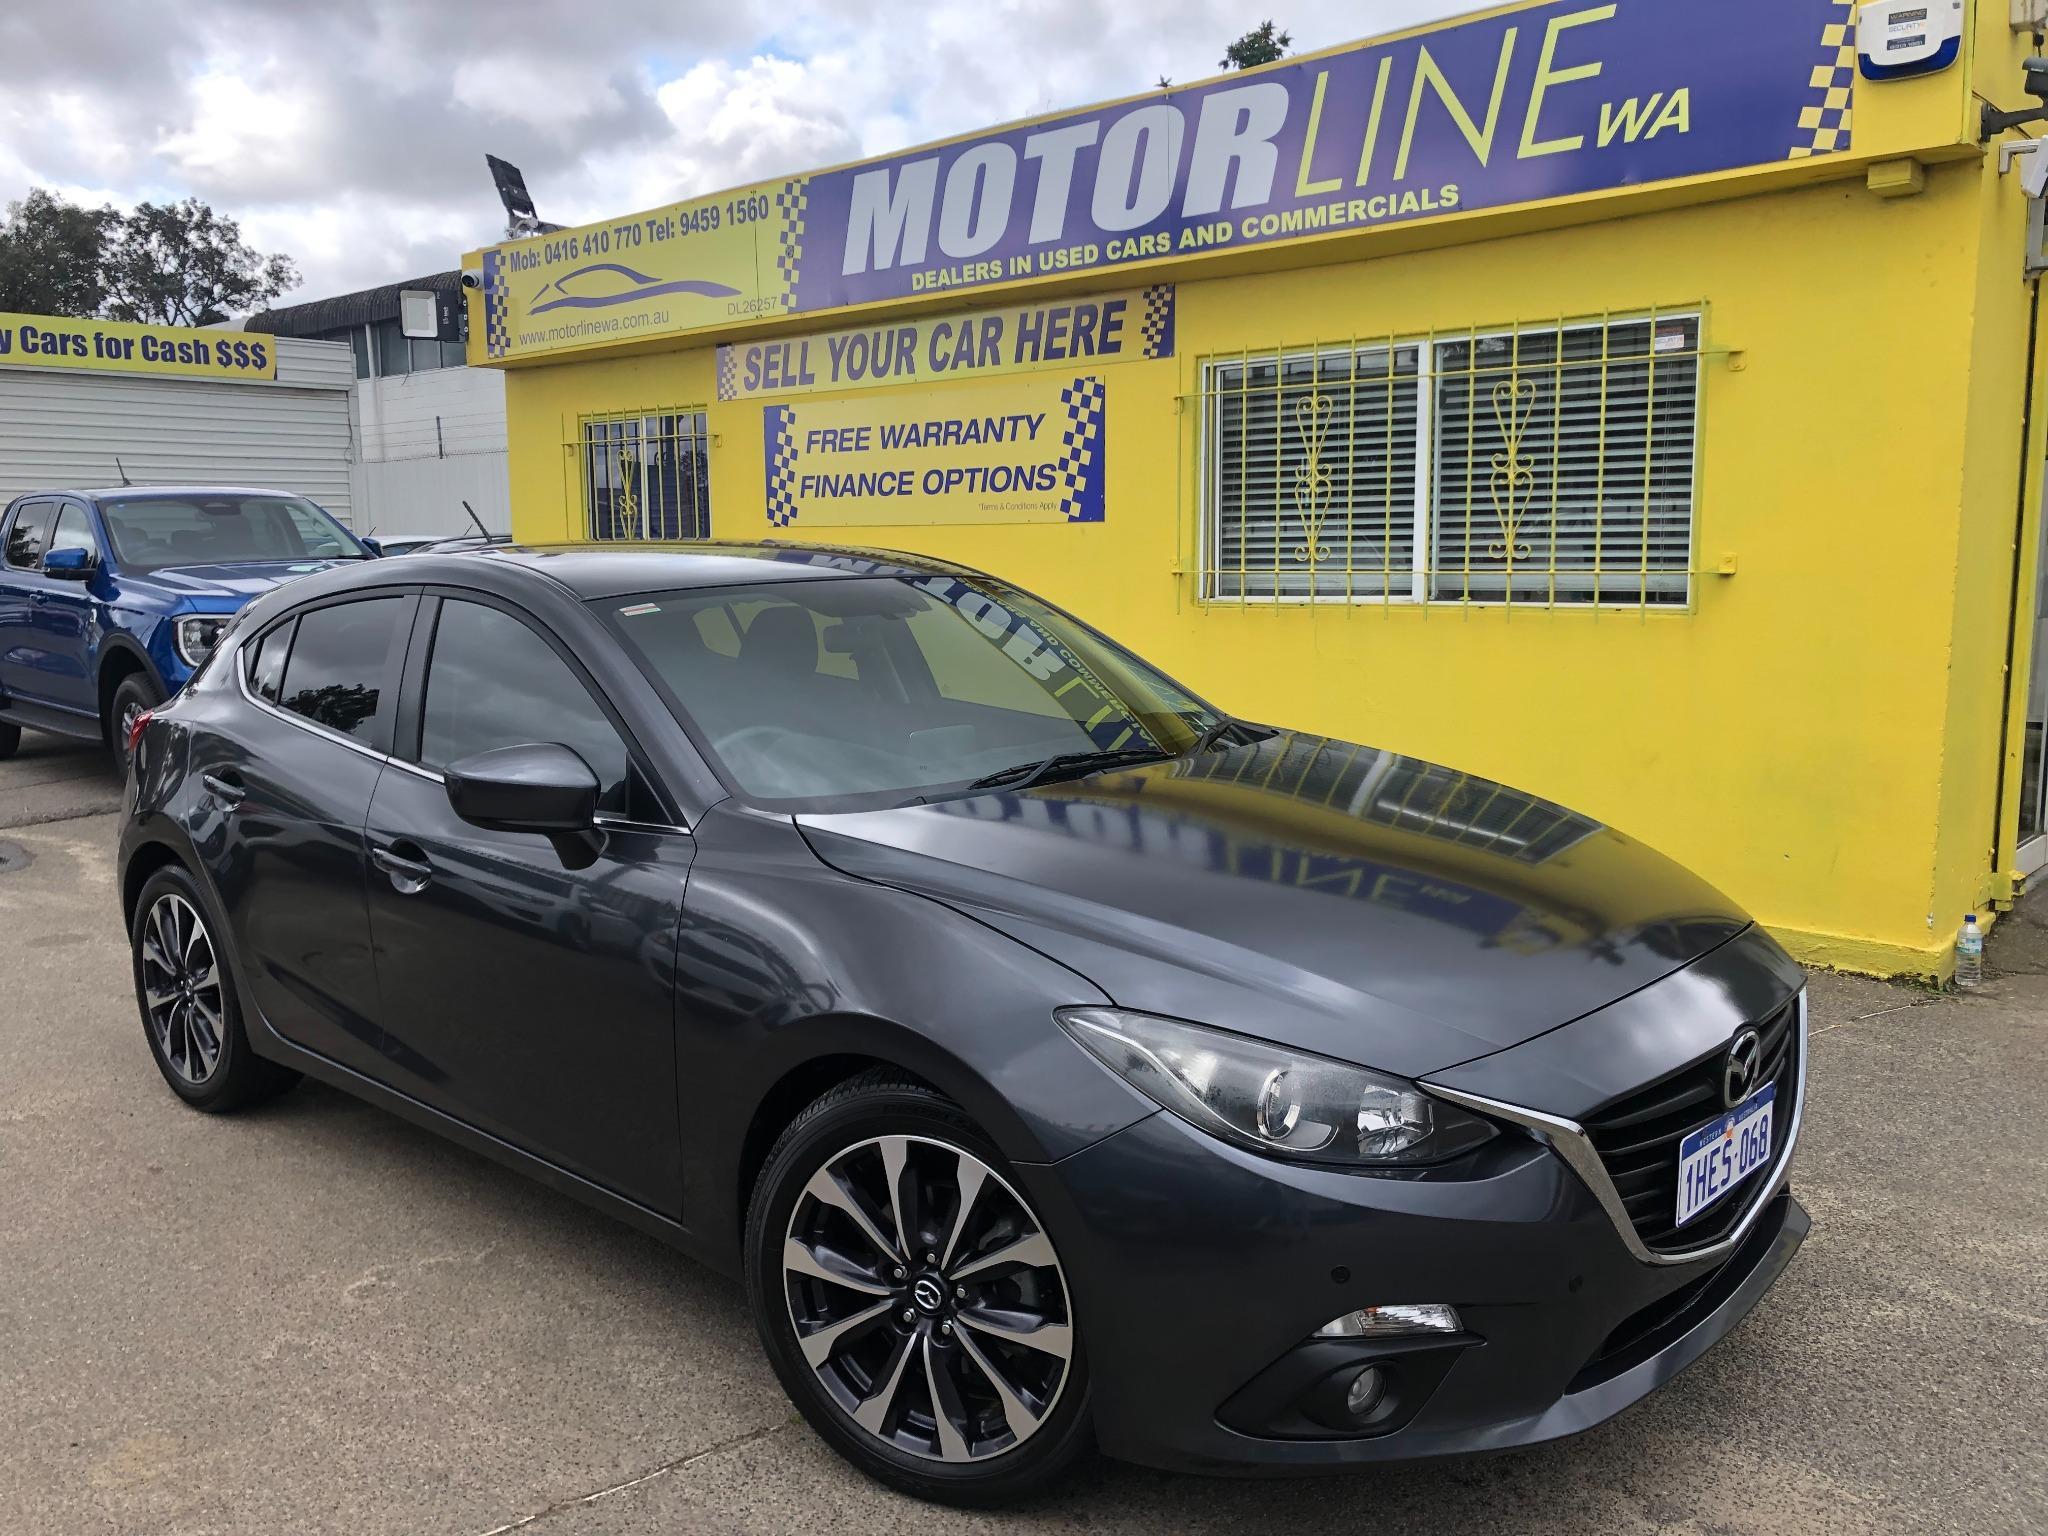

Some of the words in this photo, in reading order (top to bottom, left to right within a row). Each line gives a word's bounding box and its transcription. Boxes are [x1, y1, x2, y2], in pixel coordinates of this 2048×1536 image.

[1597, 88, 1690, 148] WA
[510, 248, 541, 272] Mob:
[545, 238, 579, 264] 0416
[582, 231, 609, 257] 410
[614, 223, 641, 249] 770
[645, 220, 675, 244] Tel:
[680, 205, 719, 236] 9459
[726, 195, 769, 226] 1560
[911, 260, 1002, 291] DEALERS
[1009, 255, 1032, 275] IN
[1039, 244, 1099, 271] USED
[1106, 232, 1171, 260] CARS
[1178, 222, 1233, 249] AND
[1241, 184, 1459, 238] COMMERCIALS
[519, 309, 669, 345] www.motorlinewa.com.au
[727, 296, 777, 316] DL26257
[19, 325, 88, 357] Cars
[93, 332, 134, 360] for
[141, 335, 210, 365] Cash
[215, 340, 267, 370] $$$
[743, 341, 816, 390] SELL
[828, 328, 918, 382] YOUR
[928, 316, 1003, 373] CAR
[1014, 299, 1128, 363] HERE
[806, 426, 872, 454] FREE
[880, 413, 1047, 450] WARRANTY
[800, 470, 915, 499] FINANCE
[922, 462, 1058, 495] OPTIONS
[1005, 502, 1038, 511] Conditions
[1039, 501, 1057, 511] Apply
